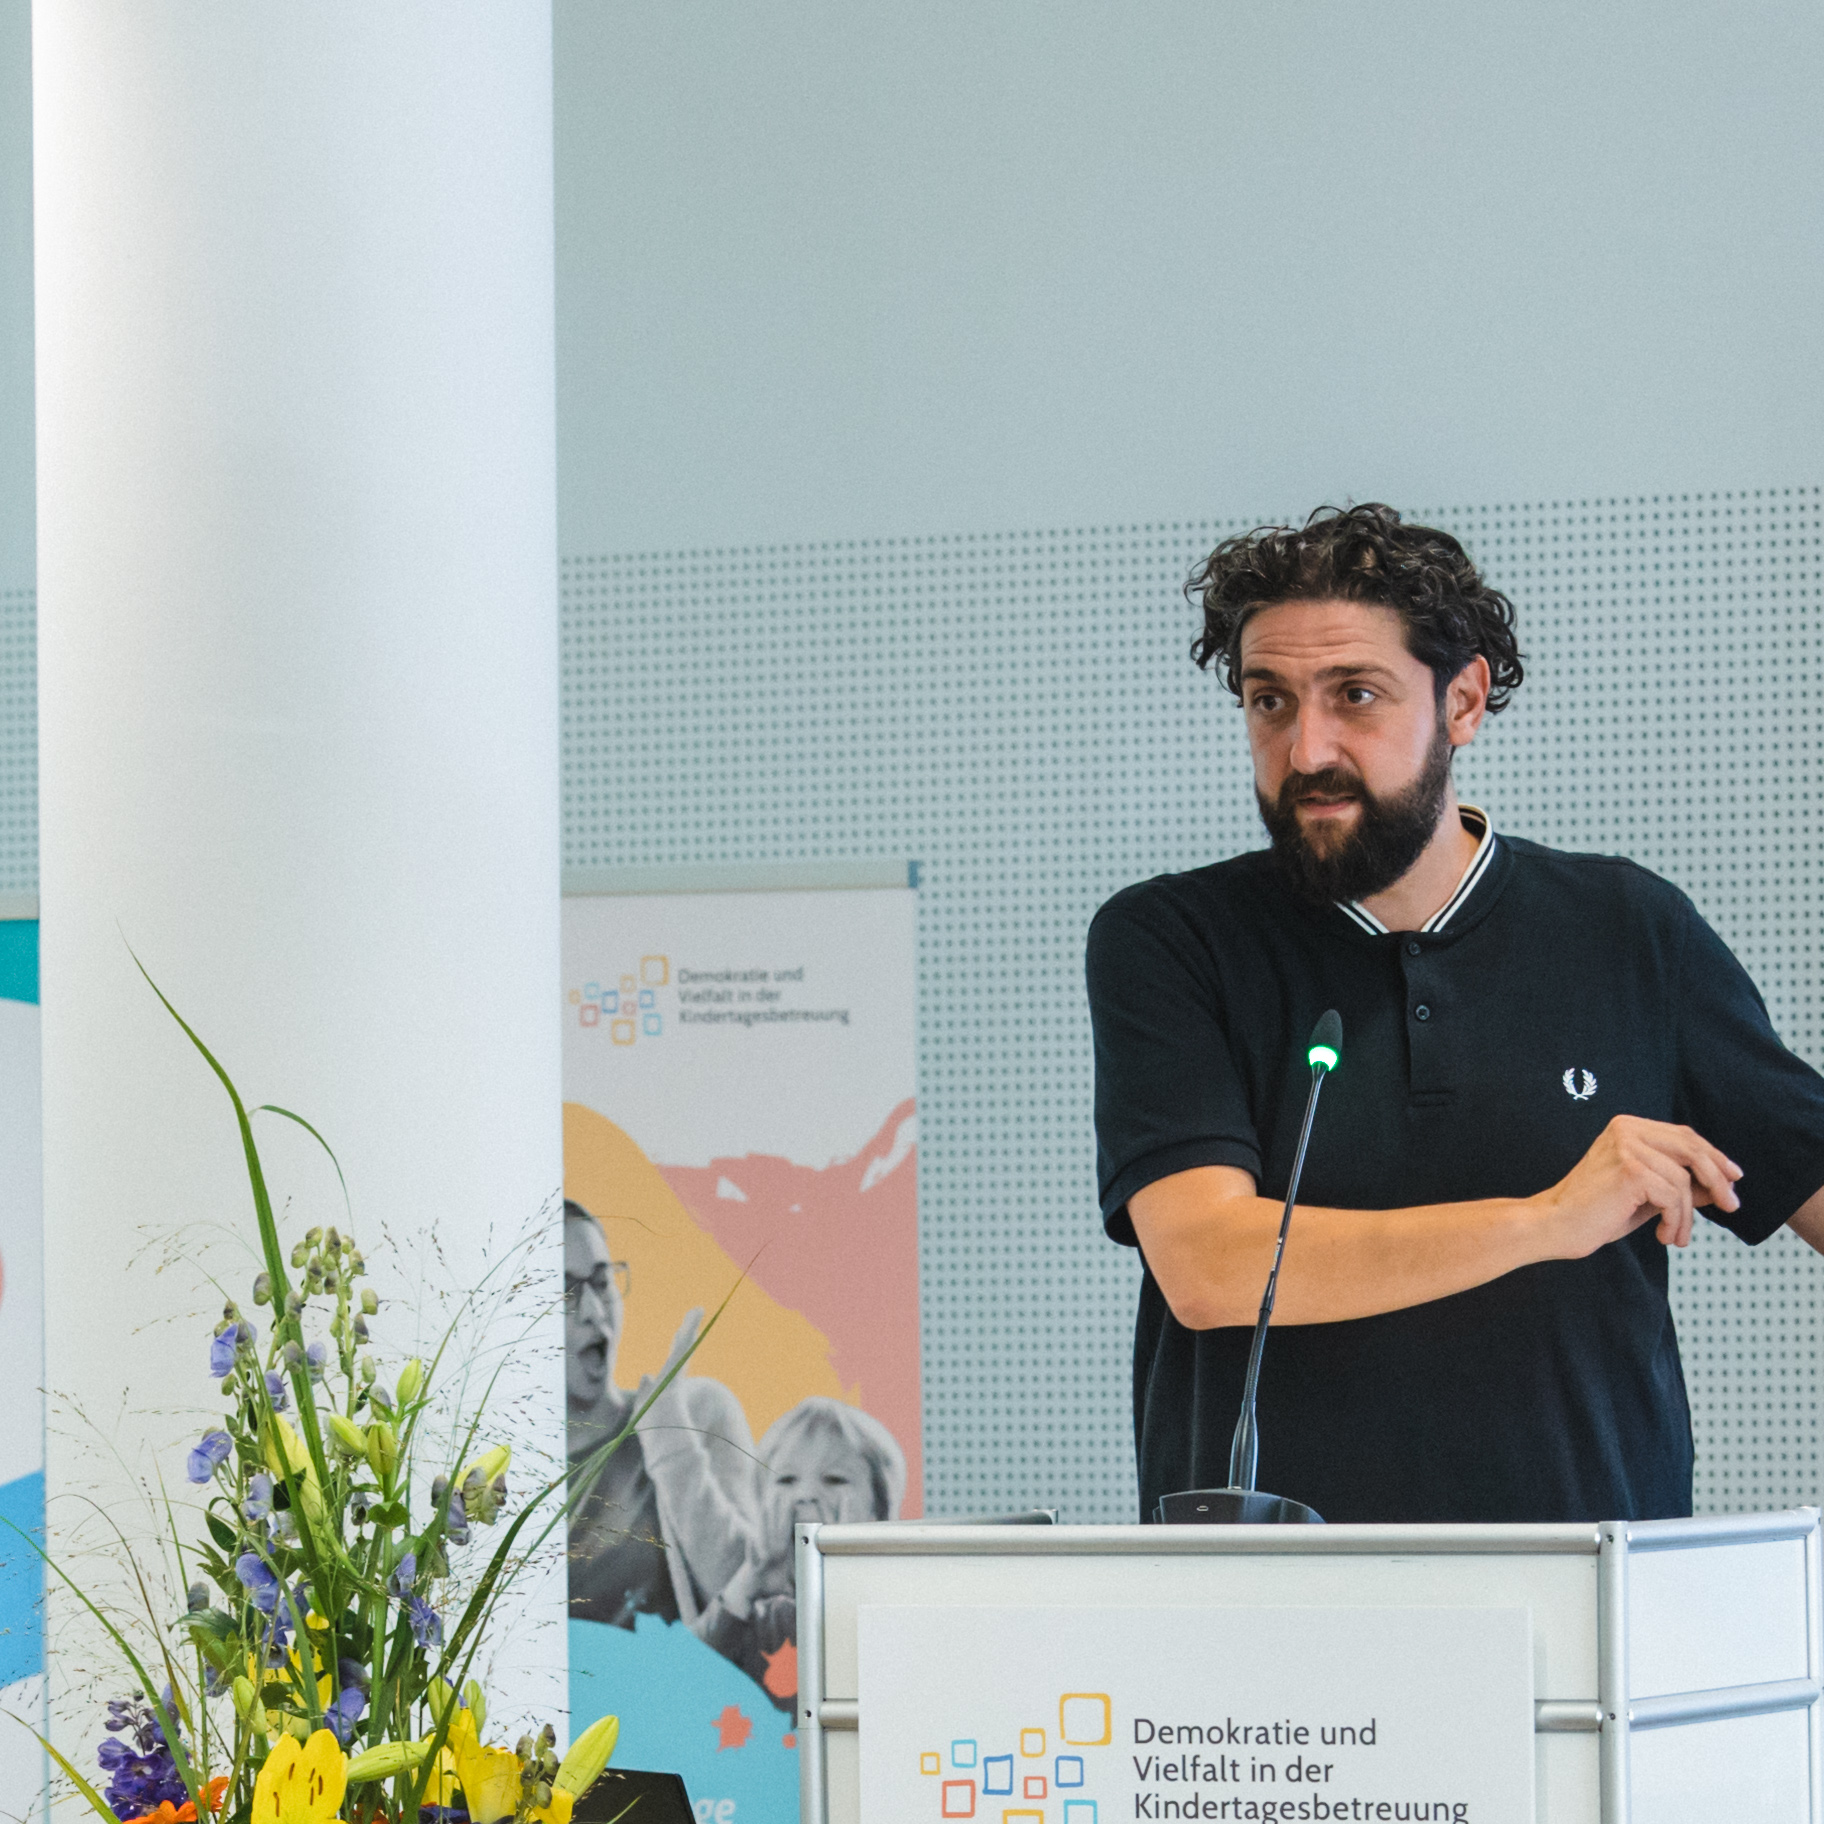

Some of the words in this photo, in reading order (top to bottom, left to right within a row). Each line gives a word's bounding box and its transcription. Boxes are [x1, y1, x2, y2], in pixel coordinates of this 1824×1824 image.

[678, 969, 769, 984] Demokratie
[774, 967, 804, 982] und
[679, 989, 733, 1003] Vielfalt
[738, 989, 753, 1002] in
[757, 987, 781, 1002] der
[679, 1008, 850, 1028] Kindertagesbetreuung
[1134, 1717, 1309, 1745] Demokratie
[1321, 1718, 1376, 1746] und
[1133, 1755, 1240, 1782] Vielfalt
[1251, 1757, 1276, 1782] in
[1285, 1755, 1333, 1783] der
